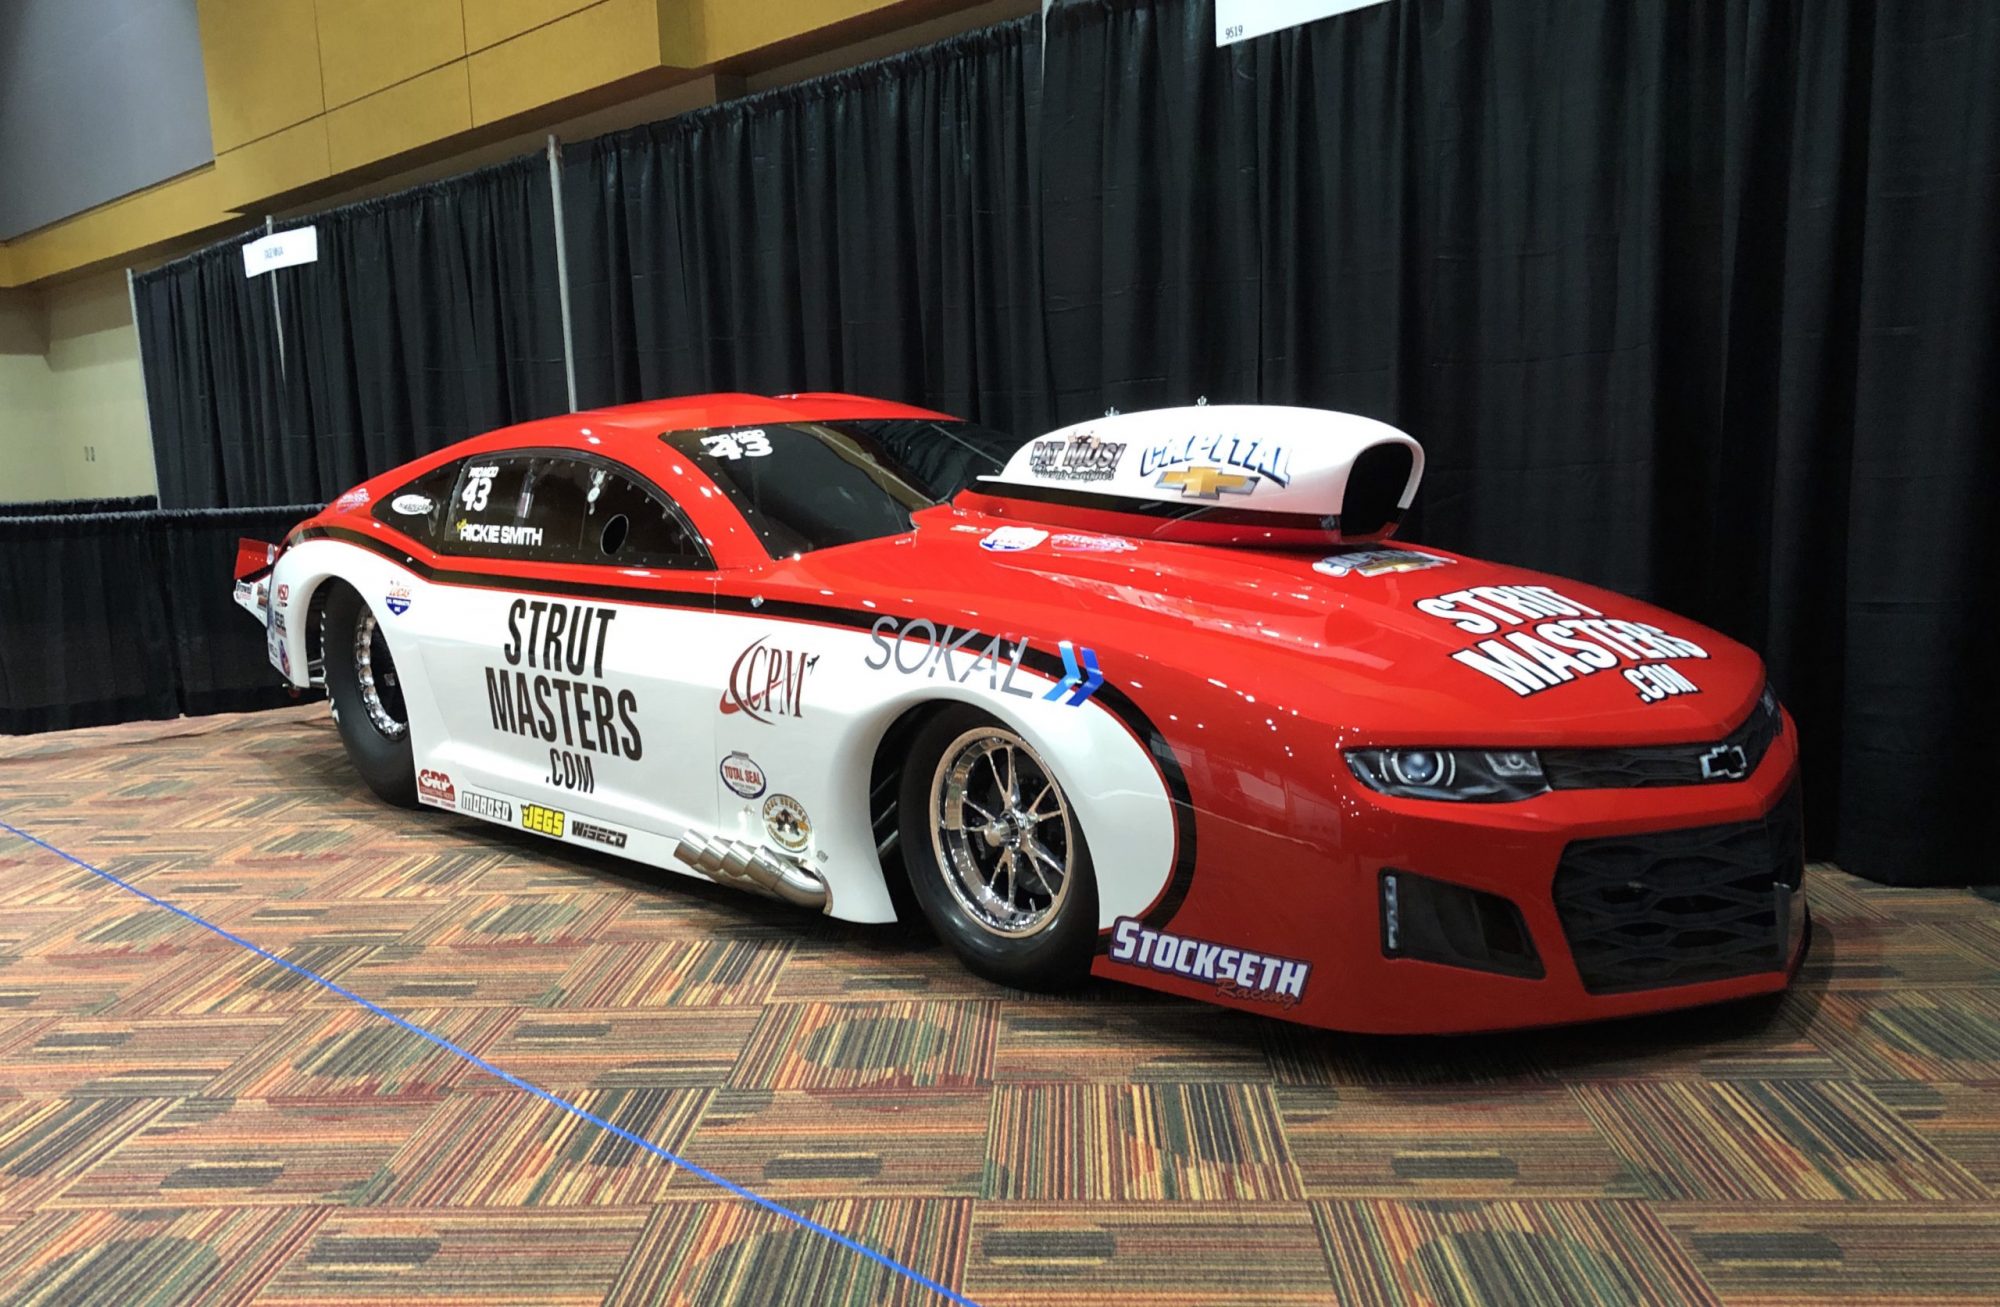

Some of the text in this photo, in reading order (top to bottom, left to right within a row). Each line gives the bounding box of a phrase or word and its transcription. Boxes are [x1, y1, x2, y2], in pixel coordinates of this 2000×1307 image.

[1225, 25, 1243, 39] 9519
[709, 437, 773, 460] 43
[1029, 441, 1127, 469] PAT MUSI
[462, 477, 492, 512] 43
[460, 524, 500, 543] RICKIE
[500, 526, 543, 546] SMITH
[1414, 585, 1604, 635] STRUT
[504, 598, 617, 679] STRUT
[864, 616, 1034, 699] SOKAL
[1449, 618, 1711, 697] MASTERS
[742, 643, 809, 719] CPM
[1621, 663, 1701, 704] .COM
[485, 666, 642, 761] MASTERS
[420, 768, 451, 792] GRP
[546, 747, 594, 794] .COM
[724, 765, 745, 782] TOTAL
[744, 769, 762, 786] SEAL
[461, 790, 512, 822] MOROSO
[522, 803, 565, 838] JEGS
[1112, 919, 1308, 998] STOCKSETH
[1215, 978, 1298, 1010] Racing
